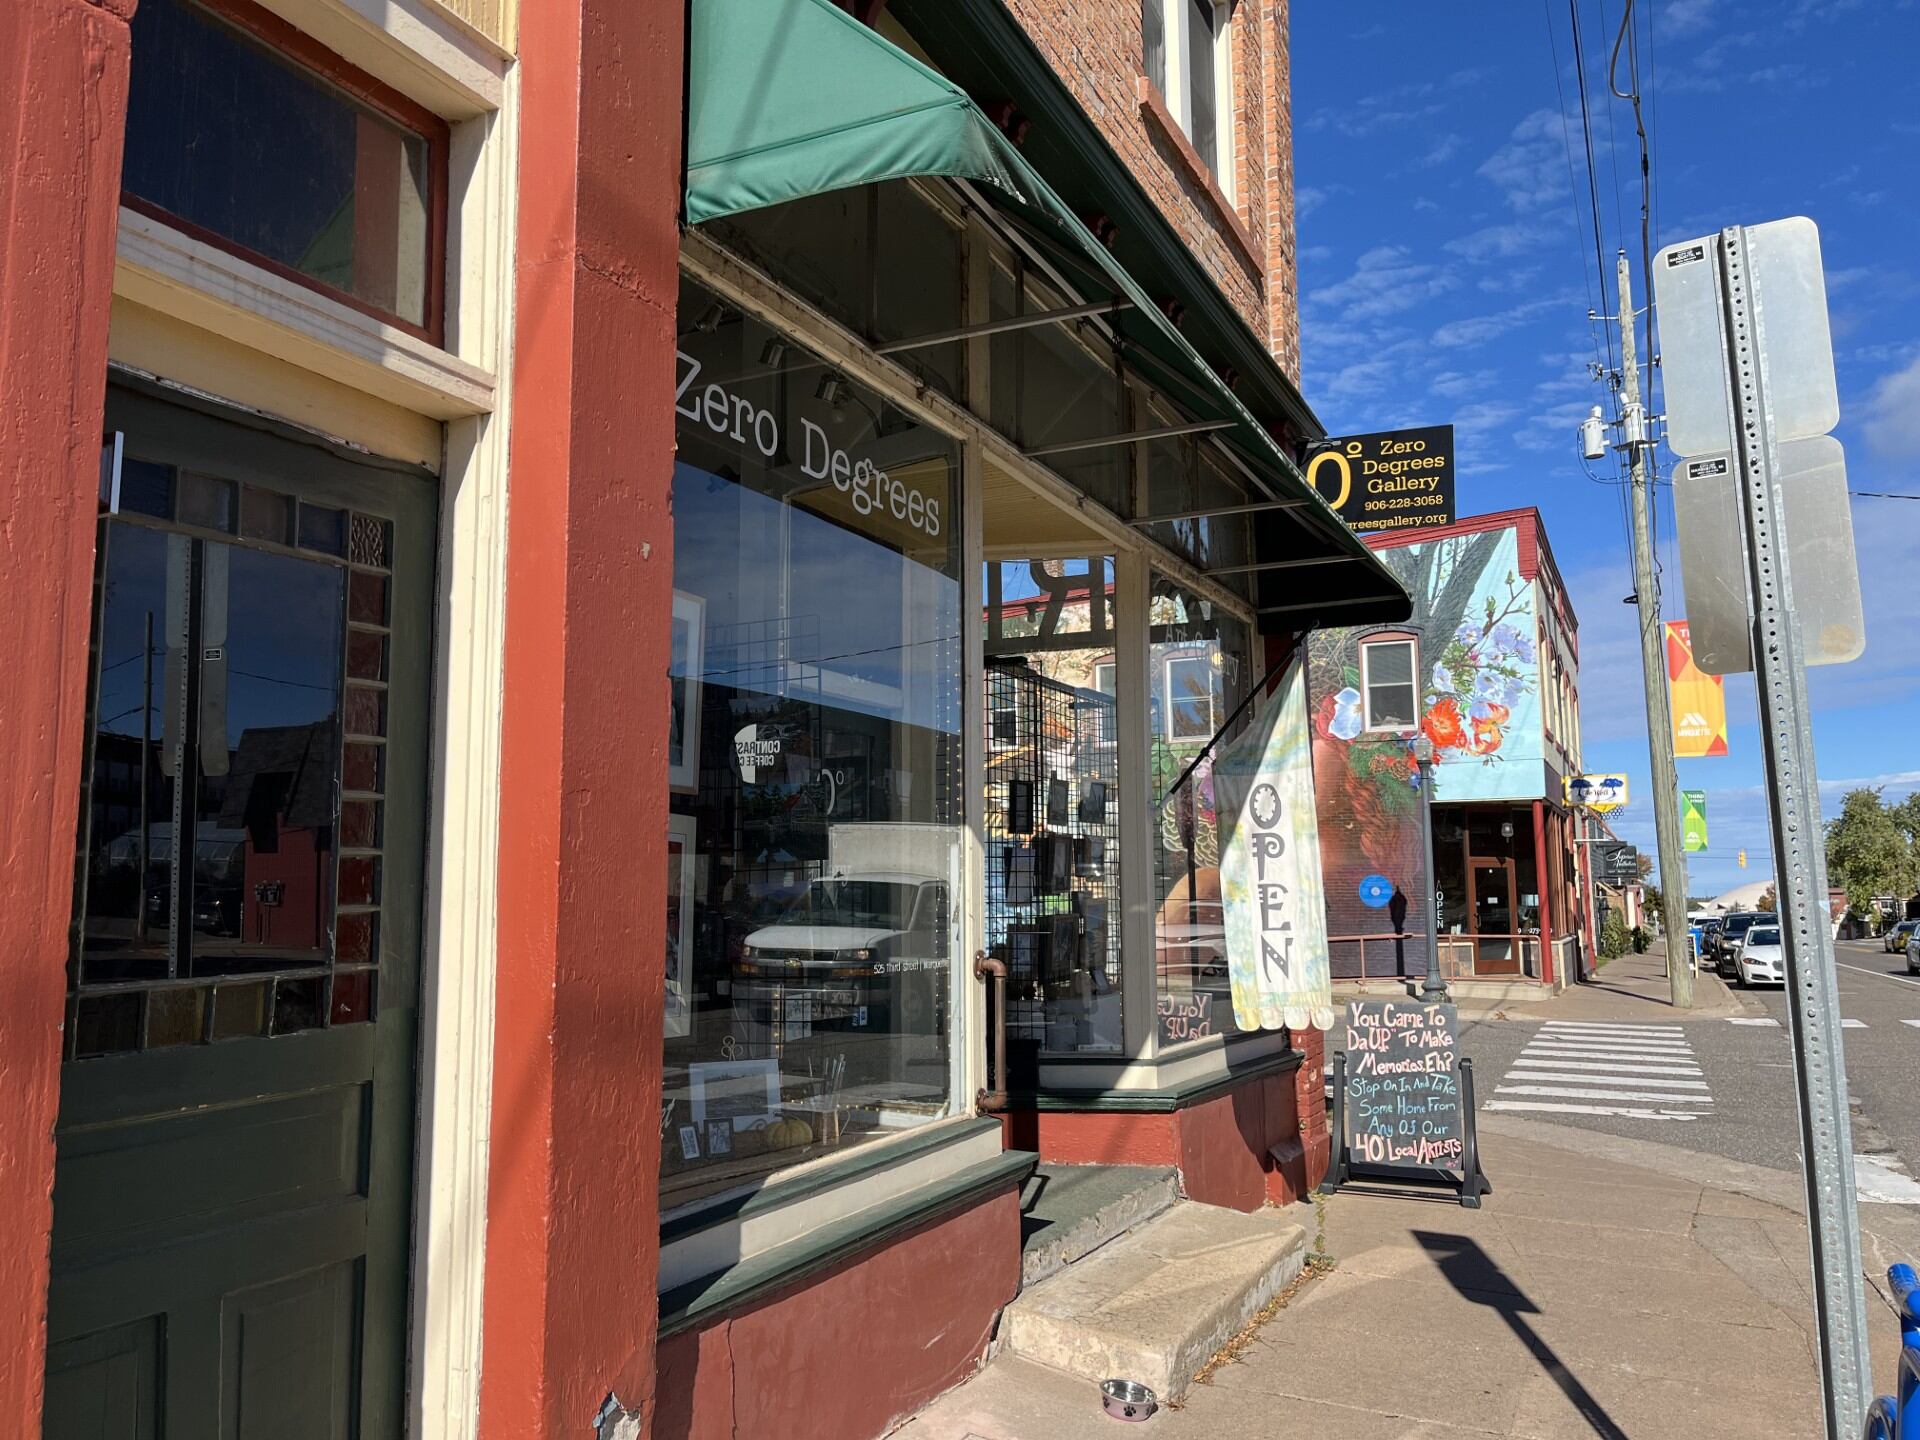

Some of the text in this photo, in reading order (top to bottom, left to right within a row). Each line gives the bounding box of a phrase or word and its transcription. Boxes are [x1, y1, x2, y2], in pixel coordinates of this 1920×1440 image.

[675, 350, 940, 536] Zero Degrees
[1380, 439, 1426, 455] Zero
[1363, 455, 1445, 475] Degrees
[1367, 475, 1440, 494] Gallery
[1364, 494, 1444, 511] 906-228-3058
[1347, 512, 1448, 531] reesgallery.org
[1250, 783, 1294, 983] OPEN
[1436, 891, 1444, 929] OPEN
[873, 962, 886, 974] 525
[1351, 1002, 1445, 1028] You Came To
[1398, 1031, 1418, 1047] To
[1350, 1078, 1380, 1097] Stop
[1383, 1080, 1398, 1091] On
[1399, 1078, 1412, 1092] In
[1413, 1076, 1429, 1089] And
[1358, 1095, 1456, 1117] Some Home From
[1368, 1116, 1449, 1137] Any Of Our
[1387, 1140, 1418, 1161] Local
